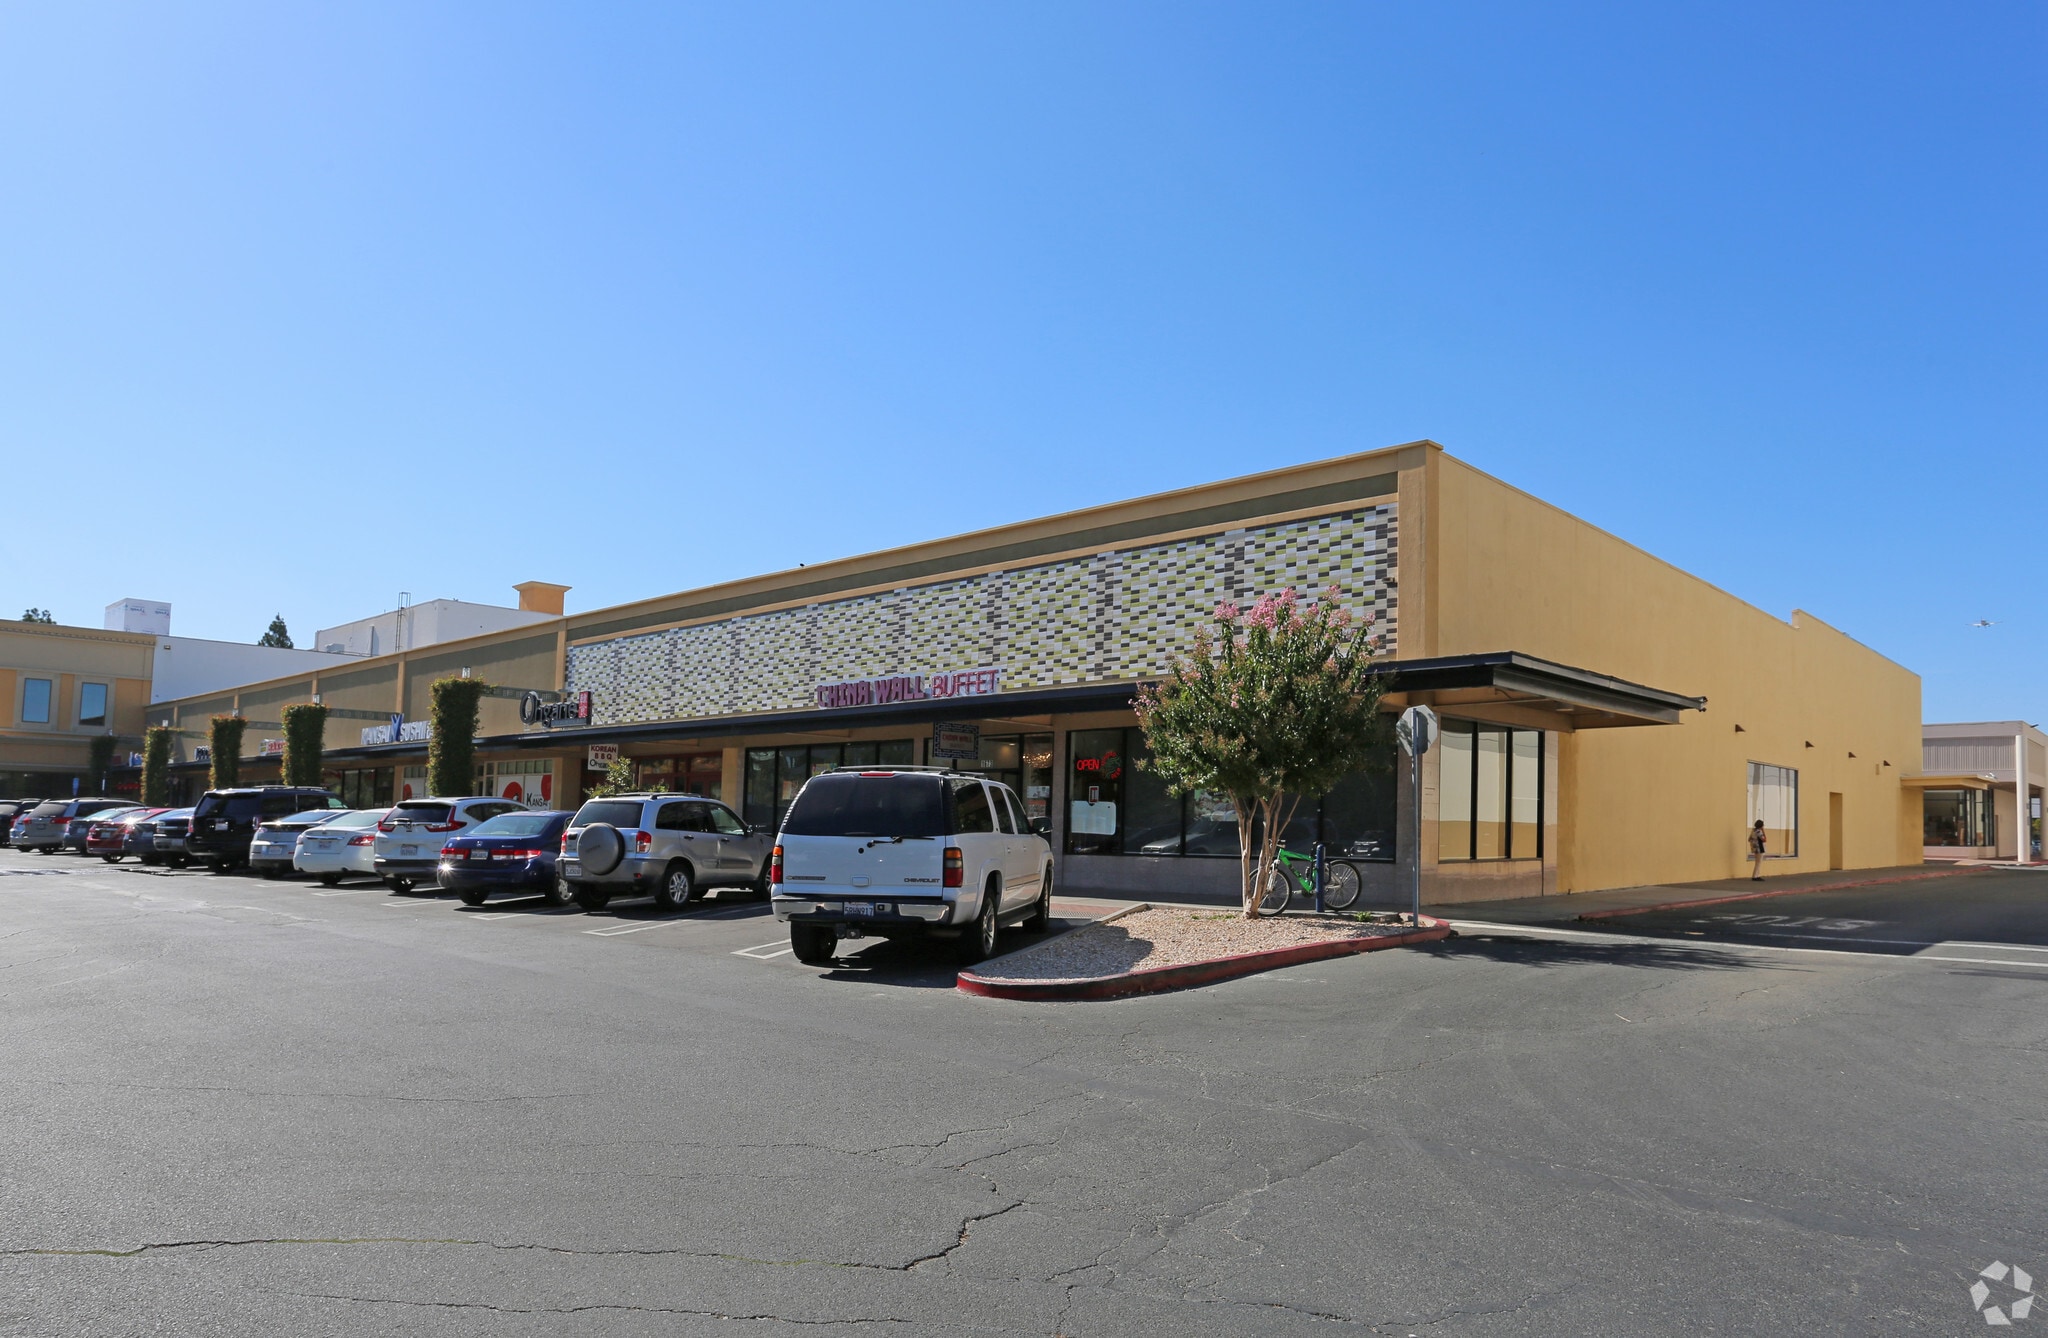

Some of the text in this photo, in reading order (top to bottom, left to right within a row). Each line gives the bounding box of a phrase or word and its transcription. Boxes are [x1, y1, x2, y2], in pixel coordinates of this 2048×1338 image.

[816, 669, 999, 708] CHINA WALL BUFFET
[400, 720, 427, 742] SUSHI
[590, 745, 617, 753] KOREAN
[1076, 759, 1100, 771] OPEN
